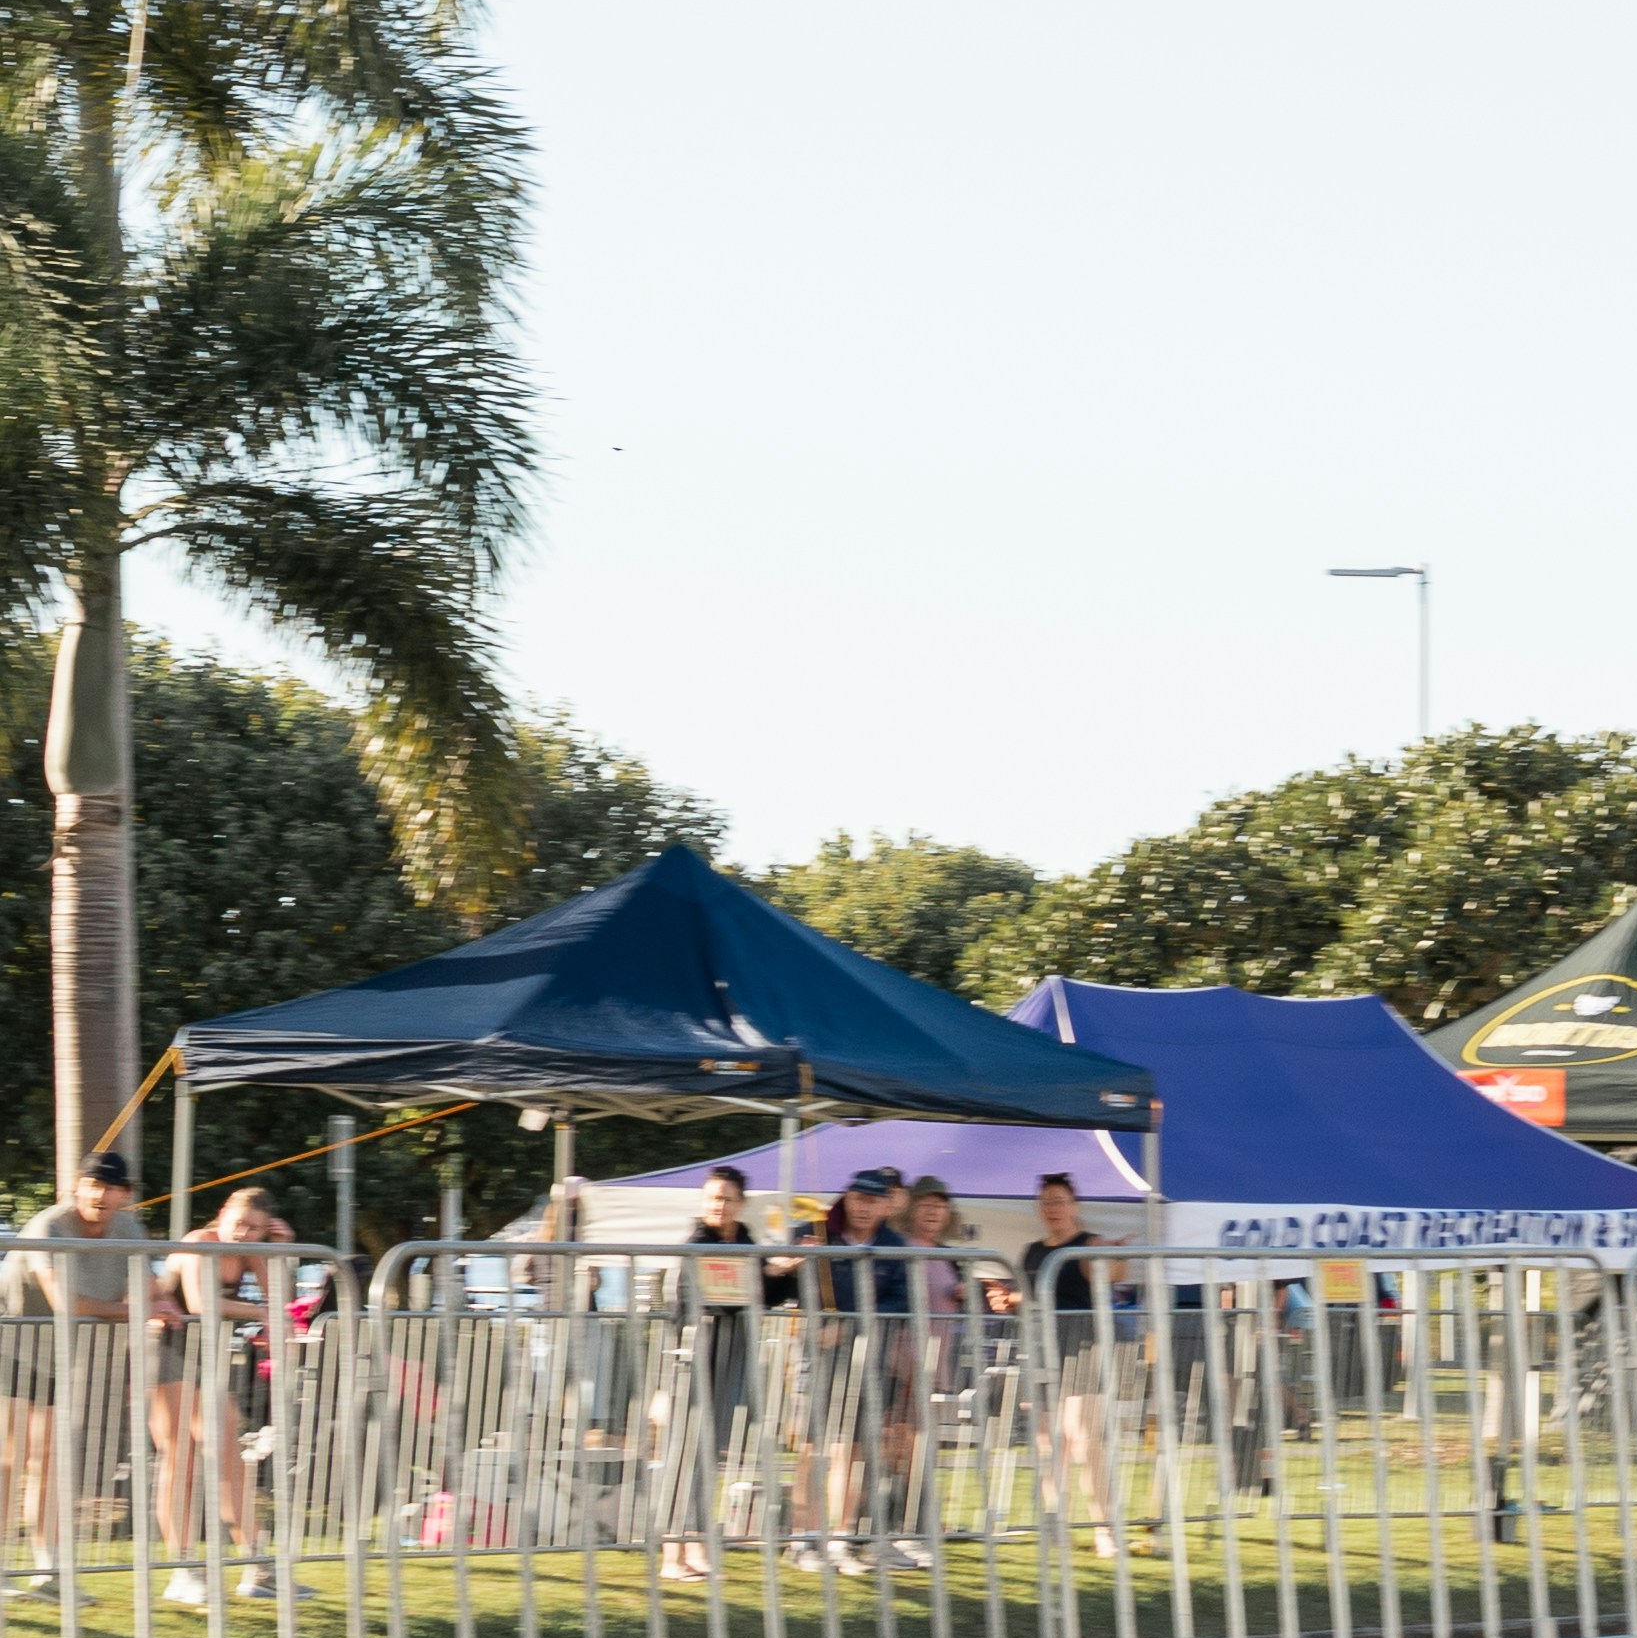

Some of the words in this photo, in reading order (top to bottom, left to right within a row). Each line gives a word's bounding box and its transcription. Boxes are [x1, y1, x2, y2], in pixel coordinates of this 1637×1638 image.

[1218, 1217, 1302, 1247] GOLD
[1310, 1211, 1411, 1247] COAST
[1416, 1210, 1586, 1246] RECREATION
